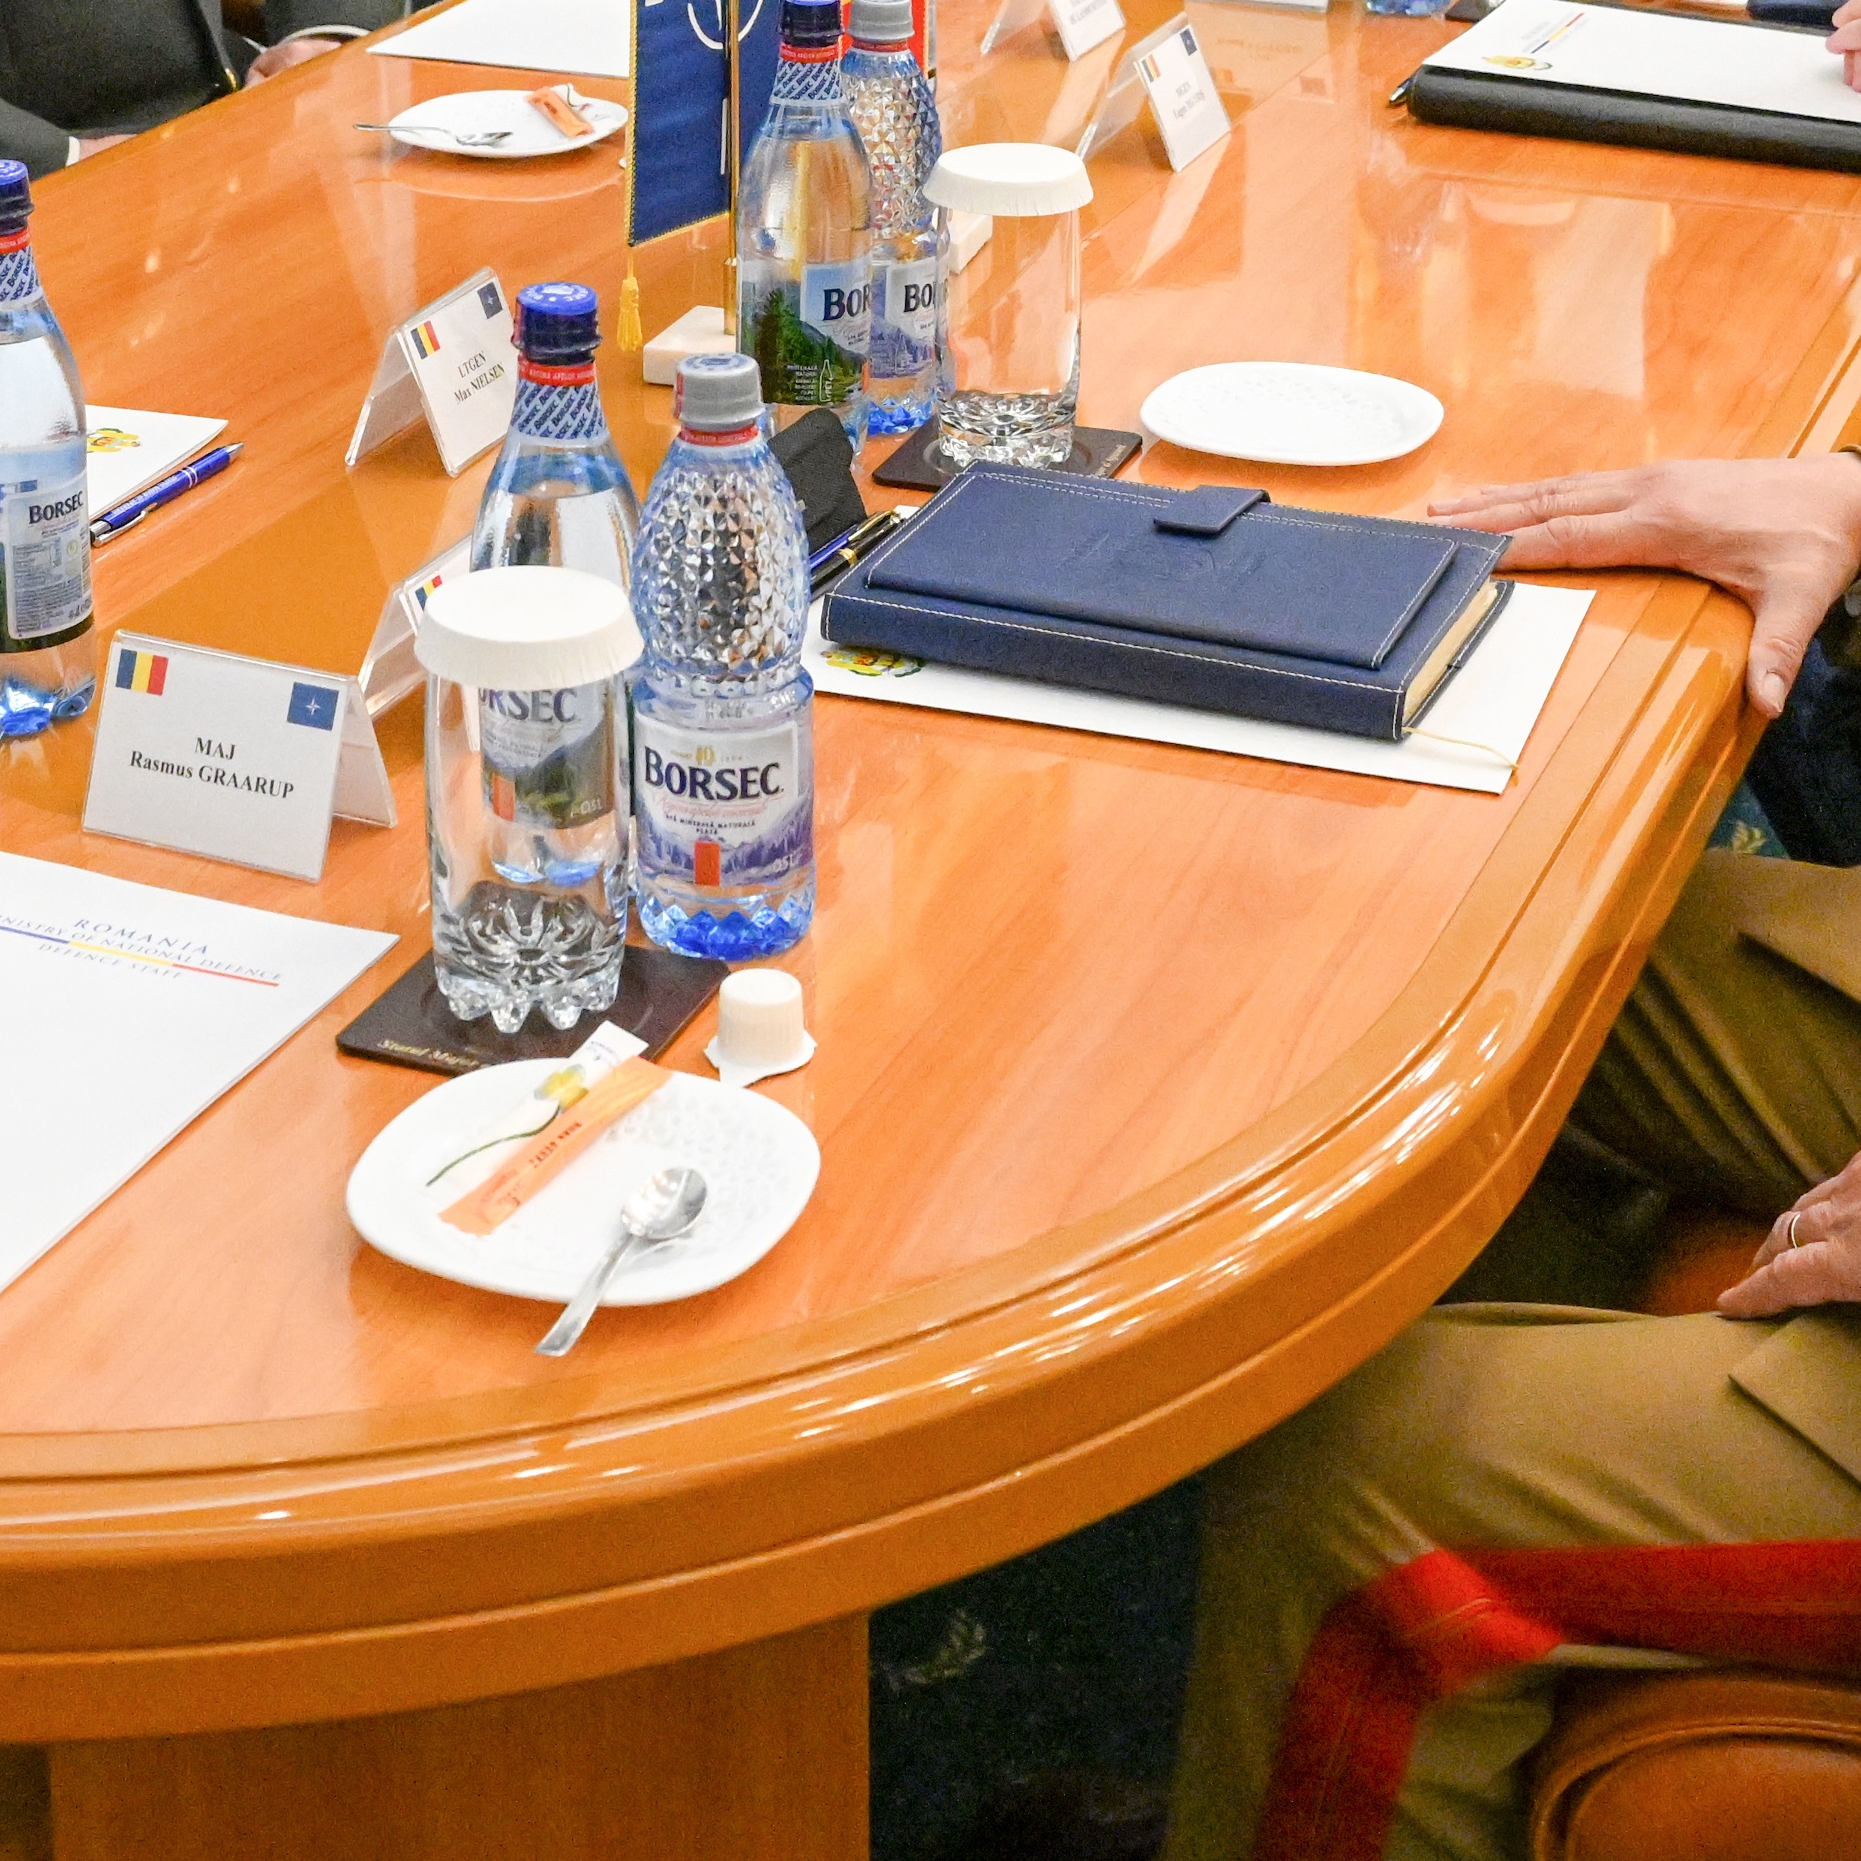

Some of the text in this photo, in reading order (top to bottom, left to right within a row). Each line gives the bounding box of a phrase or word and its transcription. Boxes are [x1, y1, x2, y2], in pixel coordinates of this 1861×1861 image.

[822, 283, 871, 321] BOR
[470, 362, 505, 393] NIELSEN
[28, 490, 84, 525] BORSEC
[194, 737, 237, 760] MAJ
[130, 750, 294, 799] Rasmus GRAARUP
[644, 745, 781, 801] BORSEC
[74, 918, 208, 955] ROMANIA
[39, 943, 182, 978] DEFENCE STAFF
[71, 932, 94, 942] OF
[101, 939, 195, 962] NATIONAL
[200, 959, 282, 980] DEFENCE
